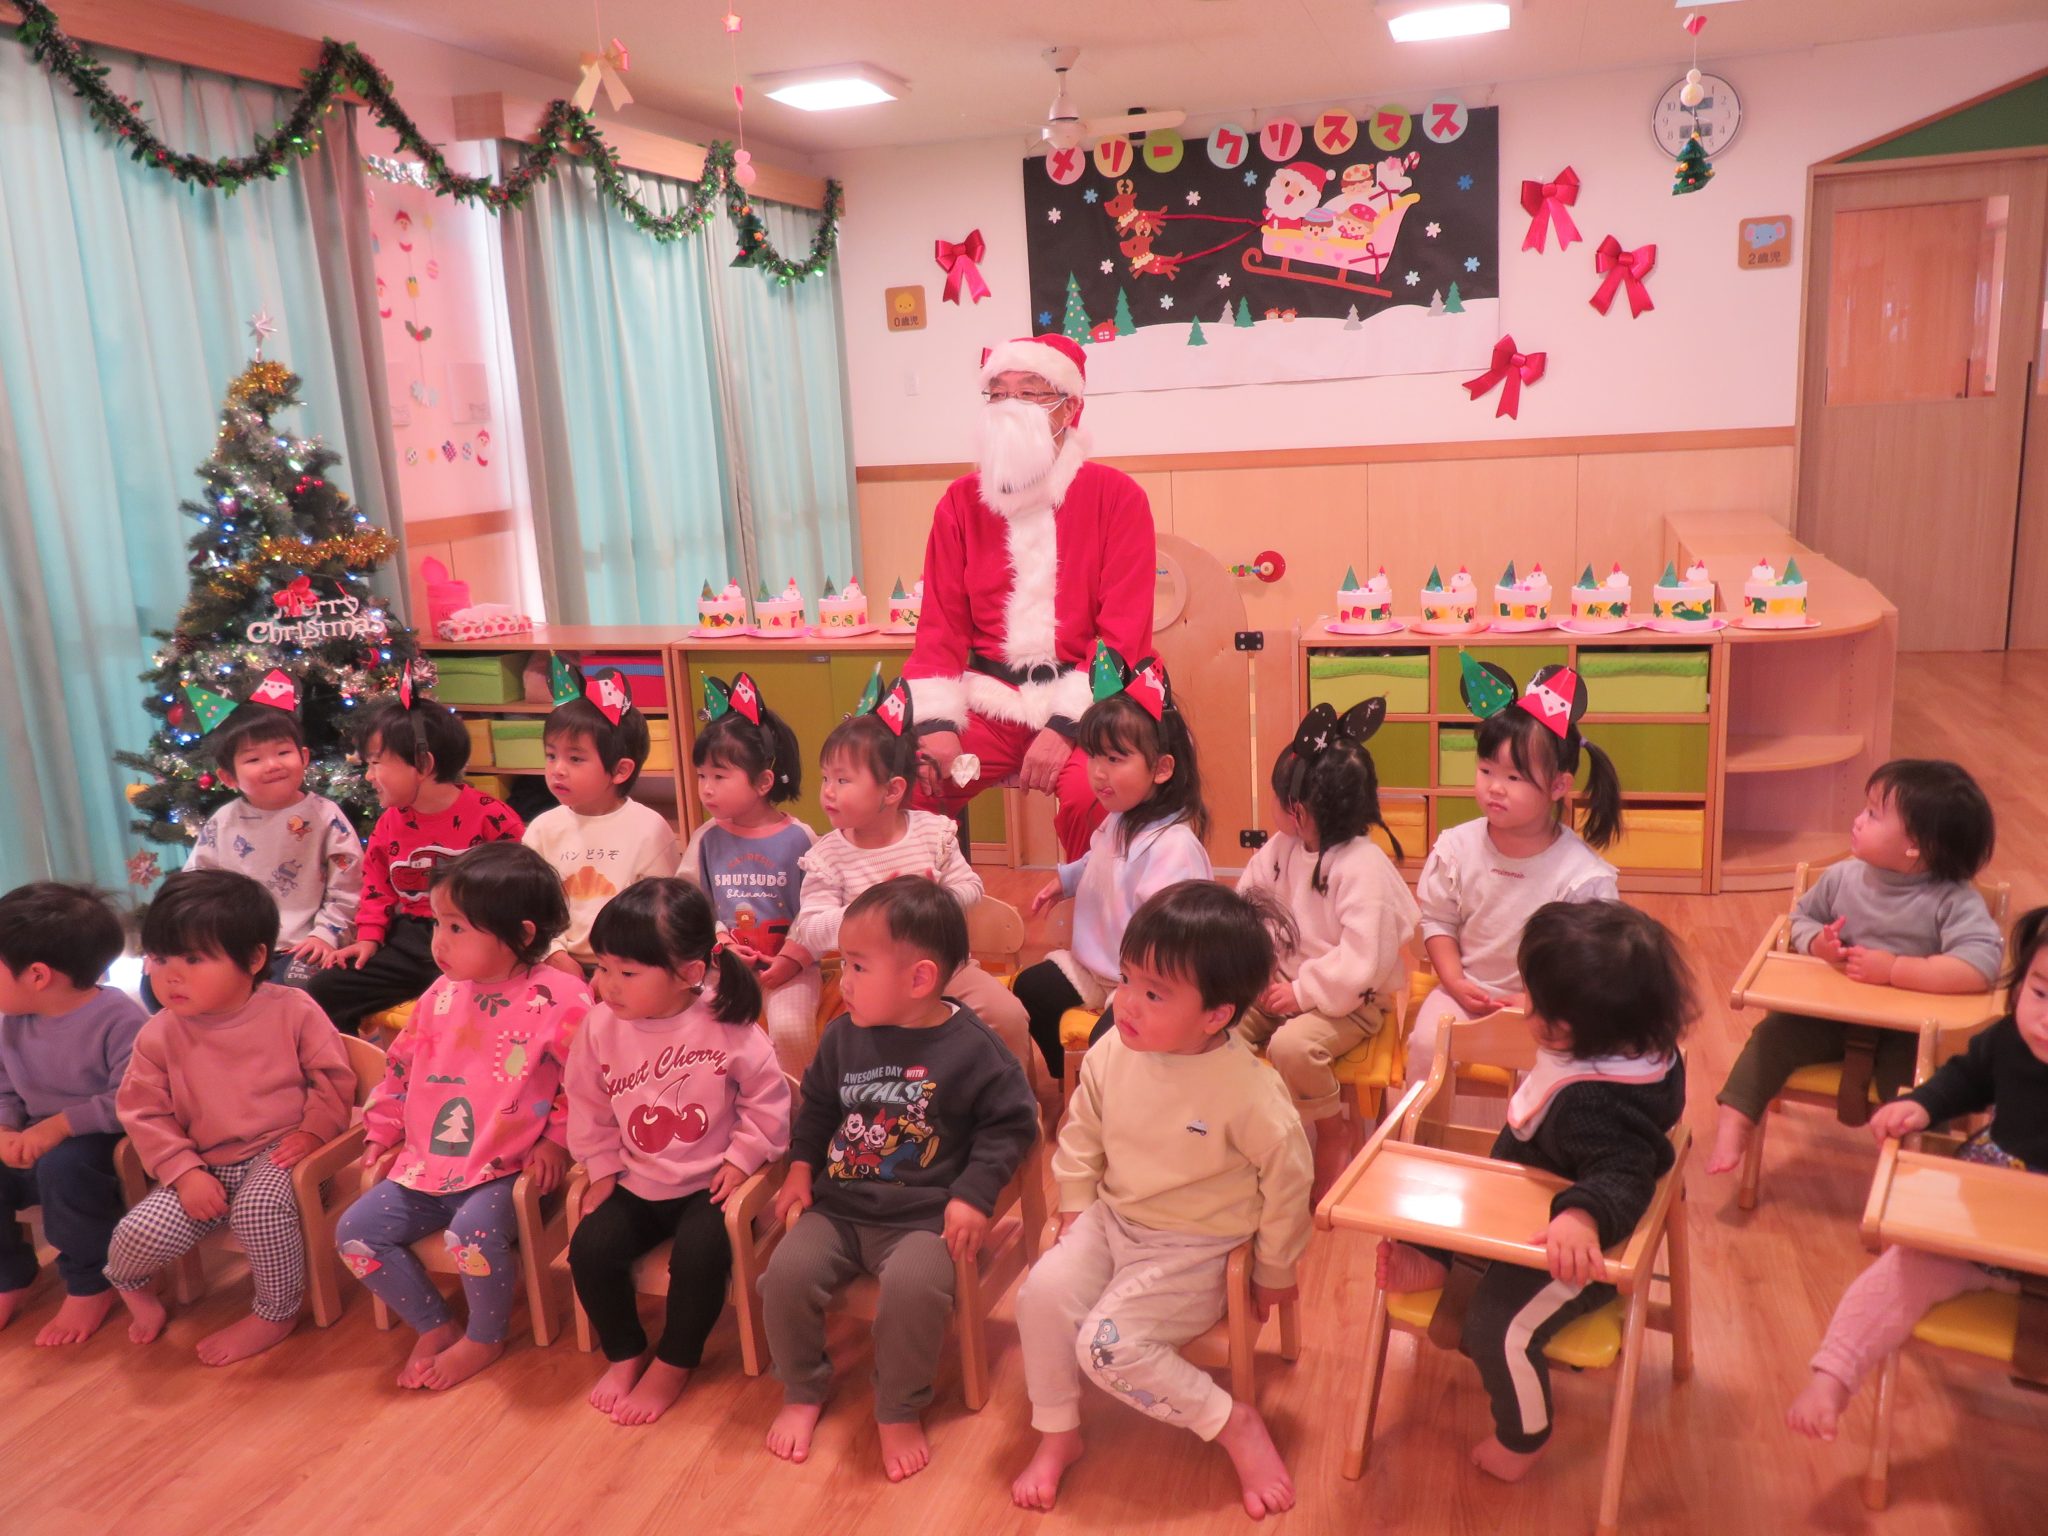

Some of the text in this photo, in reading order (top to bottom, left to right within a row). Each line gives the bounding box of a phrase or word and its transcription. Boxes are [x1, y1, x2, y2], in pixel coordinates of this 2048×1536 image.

[1052, 103, 1461, 181] メリー クリスマス
[247, 617, 386, 645] Christmas
[586, 848, 619, 860] どうぞ
[654, 1044, 727, 1079] Cherry
[843, 1065, 925, 1084] AWESOME DAY WITH
